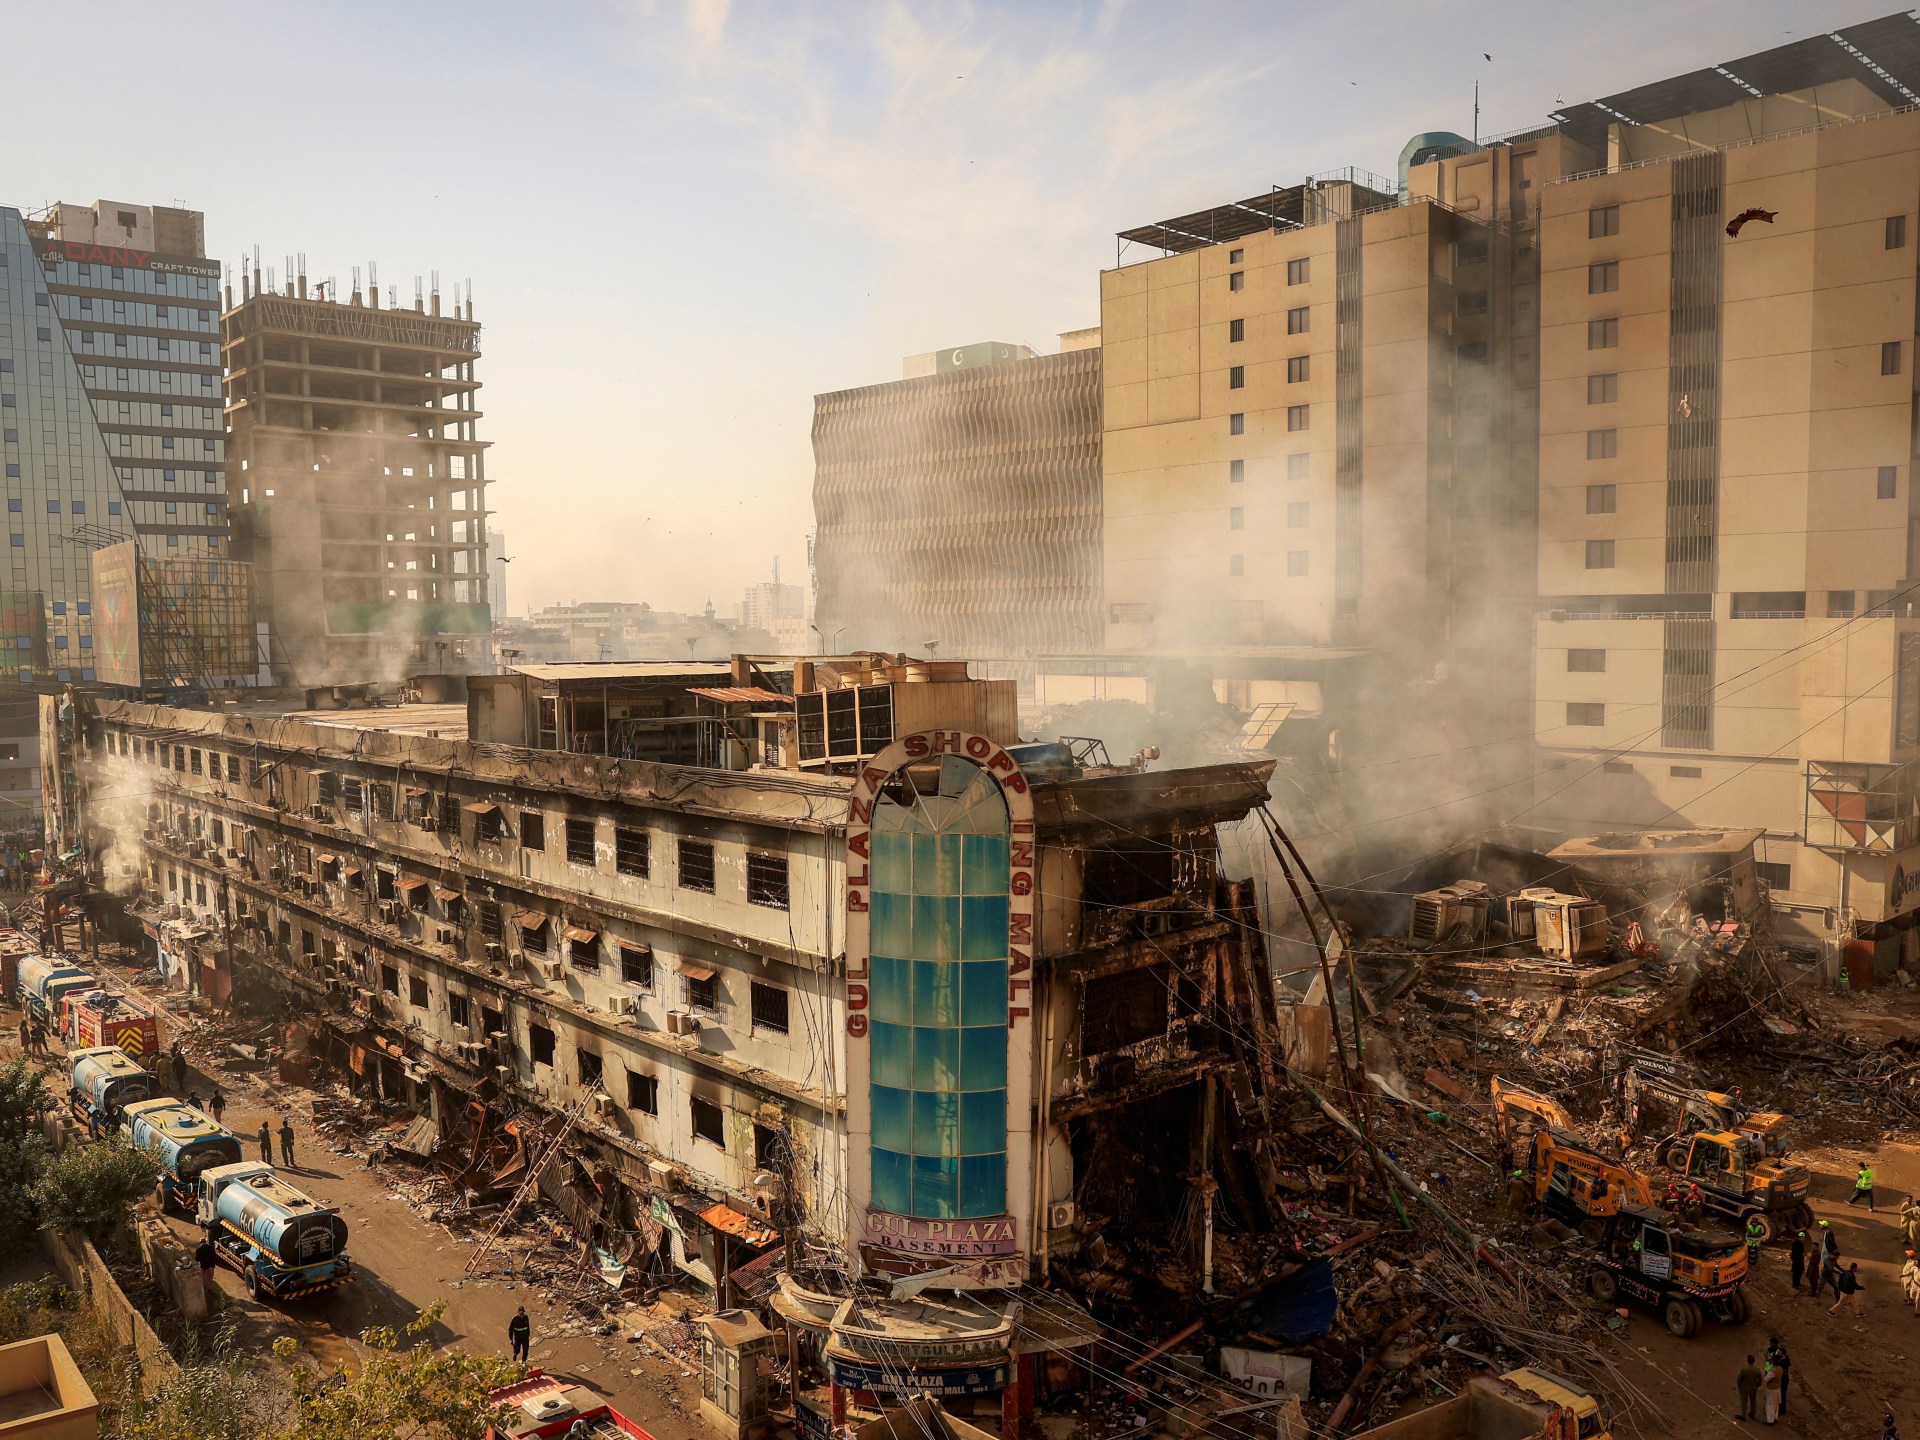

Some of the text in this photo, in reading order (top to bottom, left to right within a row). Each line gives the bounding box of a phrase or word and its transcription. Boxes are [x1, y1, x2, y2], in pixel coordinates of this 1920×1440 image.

[65, 241, 150, 268] DANY
[150, 260, 184, 273] CRAFT
[186, 266, 220, 278] TOWER
[847, 766, 889, 913] PLAZA
[1008, 912, 1033, 1030] MALL
[846, 957, 869, 1039] GUL
[1637, 1058, 1664, 1070] VOLVO
[1652, 1089, 1680, 1103] VOLVO
[1567, 1156, 1599, 1172] HYUNDA
[867, 1213, 1016, 1242] GUL PLAZA
[881, 1235, 1000, 1254] BASEMENT
[881, 1373, 944, 1388] GUL PLAZA
[944, 1385, 966, 1395] MALL
